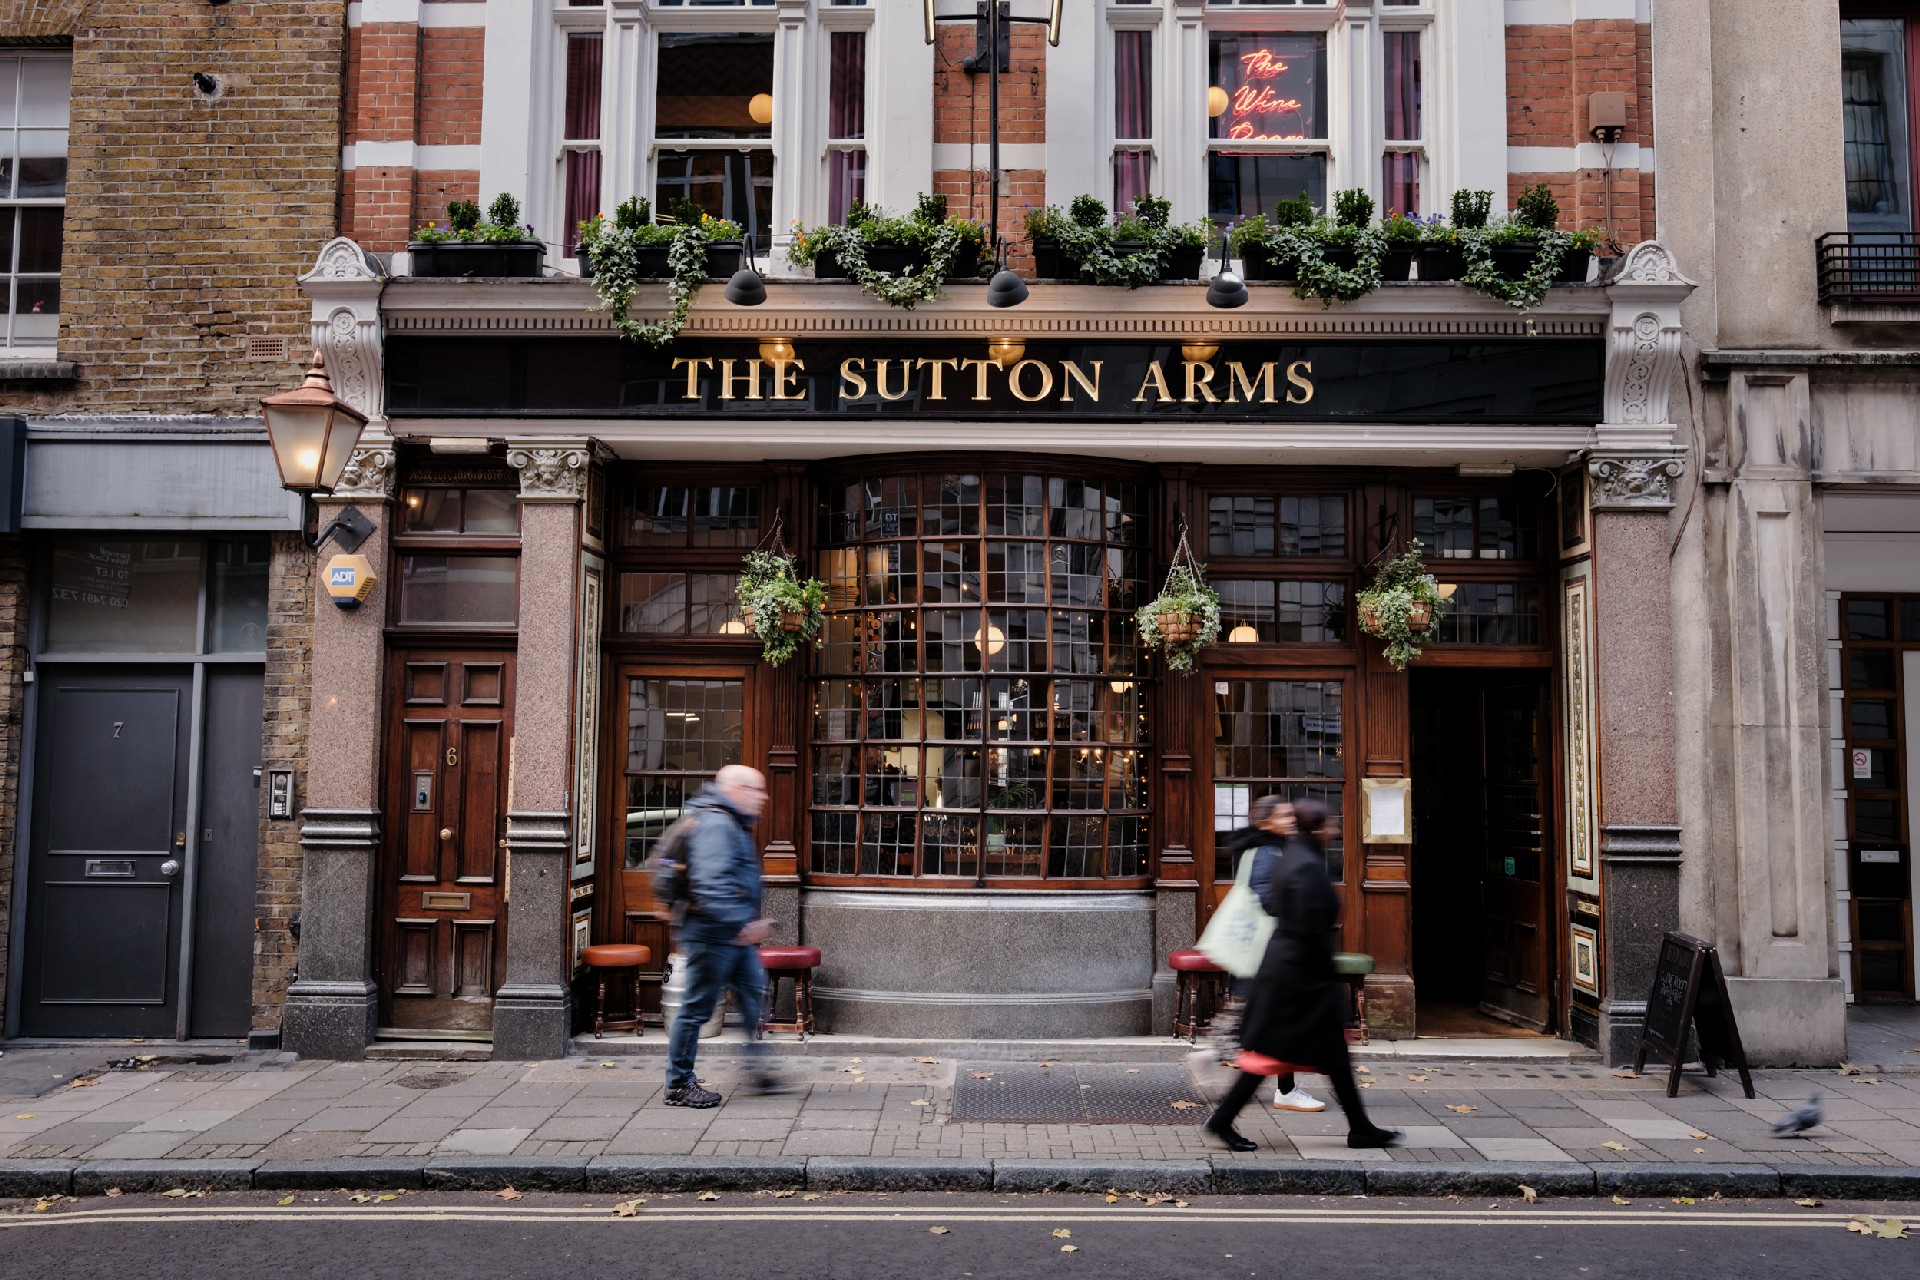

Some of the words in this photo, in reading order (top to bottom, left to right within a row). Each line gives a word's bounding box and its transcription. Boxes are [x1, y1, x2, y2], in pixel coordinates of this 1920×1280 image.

[1240, 48, 1289, 75] The
[1234, 85, 1302, 111] Wine
[672, 357, 806, 400] THE
[838, 357, 1104, 402] SUTTON
[1131, 359, 1314, 404] ARMS
[331, 571, 356, 582] ADT
[112, 721, 125, 740] 7
[446, 747, 458, 767] 6
